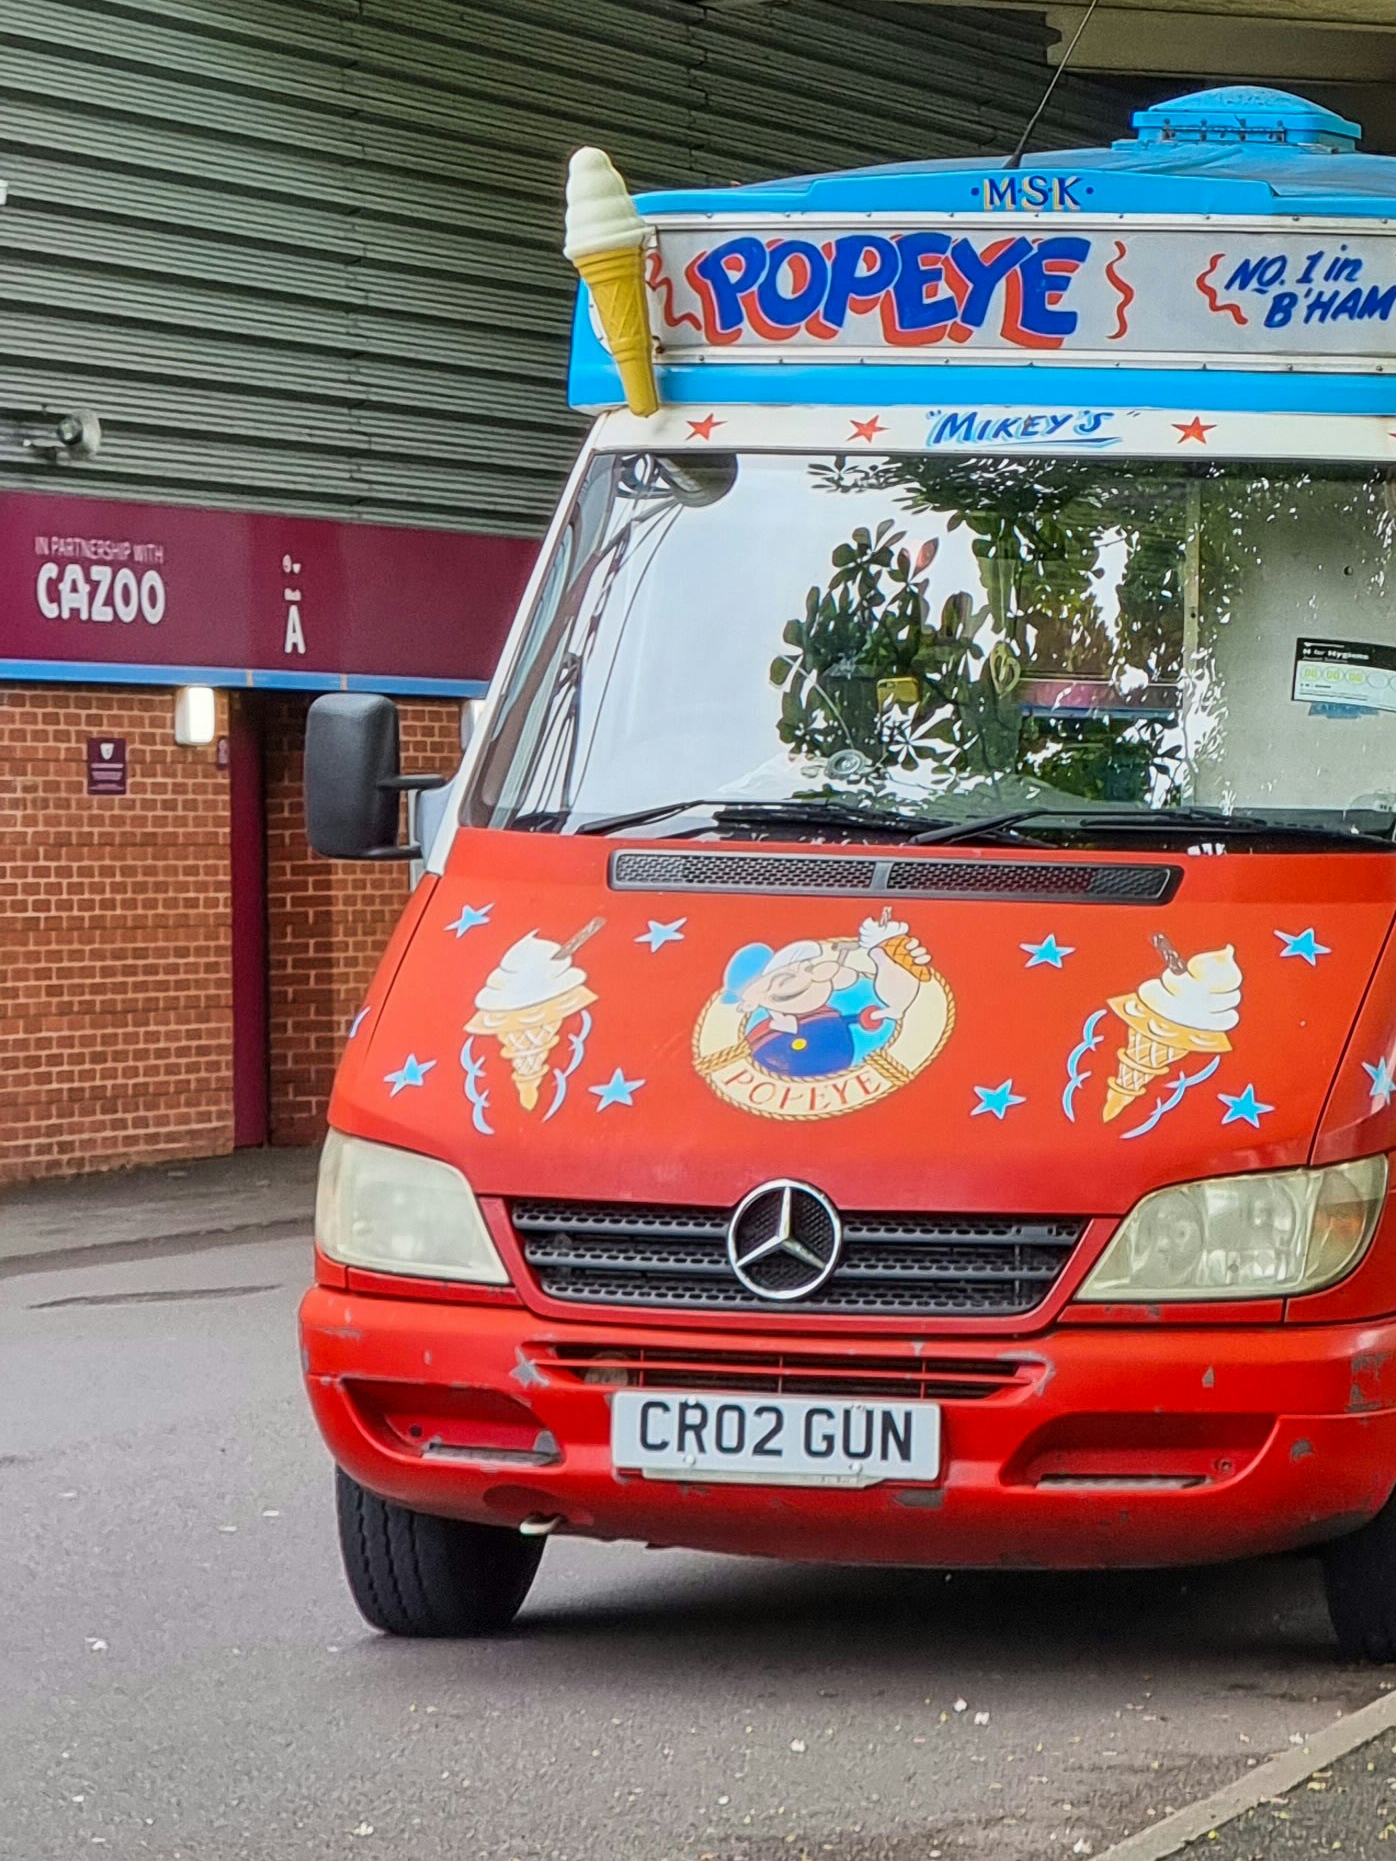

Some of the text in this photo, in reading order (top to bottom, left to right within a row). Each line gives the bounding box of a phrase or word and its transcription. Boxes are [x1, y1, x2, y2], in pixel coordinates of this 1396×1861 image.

[685, 231, 1092, 348] POPEYE
[1296, 250, 1325, 284] 1
[1323, 244, 1363, 283] in
[37, 562, 165, 624] CAZOO
[722, 1069, 881, 1111] POPEYE
[804, 1407, 912, 1462] GUN
